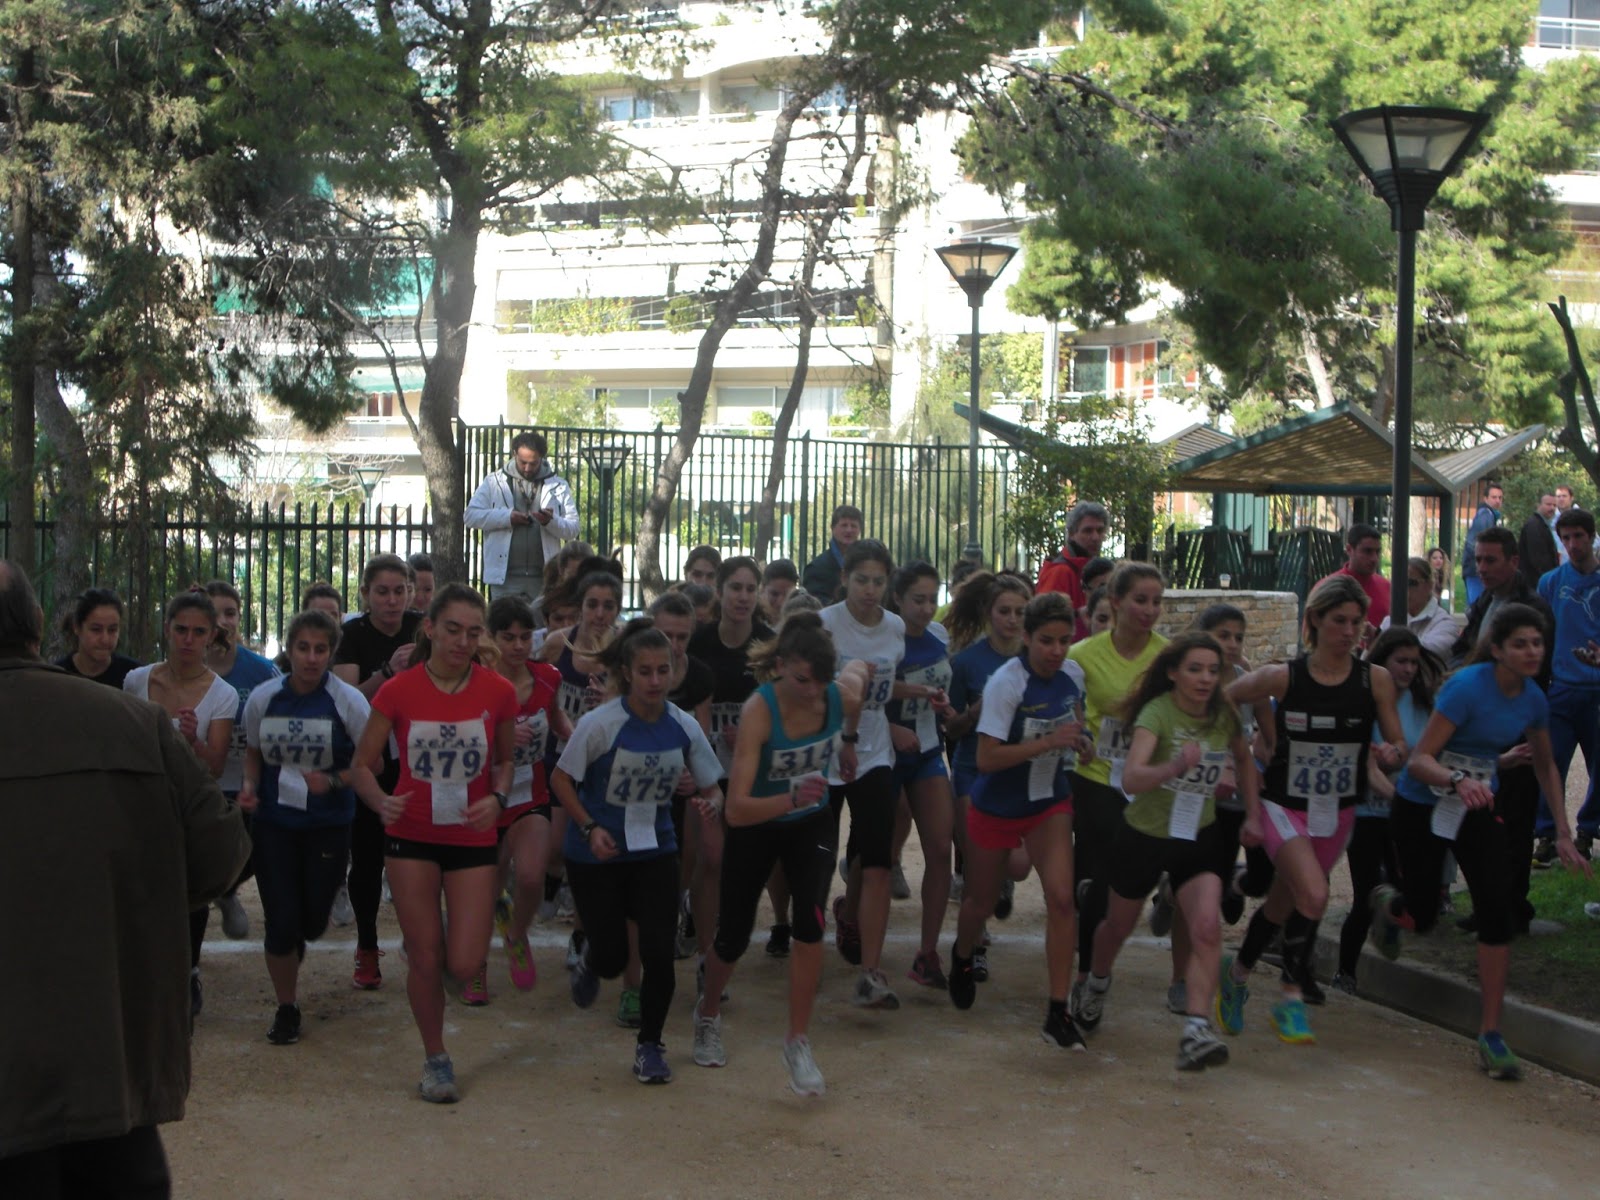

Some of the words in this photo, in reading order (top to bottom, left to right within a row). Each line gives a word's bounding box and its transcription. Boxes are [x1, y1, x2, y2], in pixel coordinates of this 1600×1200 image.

[268, 744, 325, 766] 477
[414, 750, 482, 779] 479
[613, 775, 673, 802] 475
[1293, 766, 1352, 796] 488
